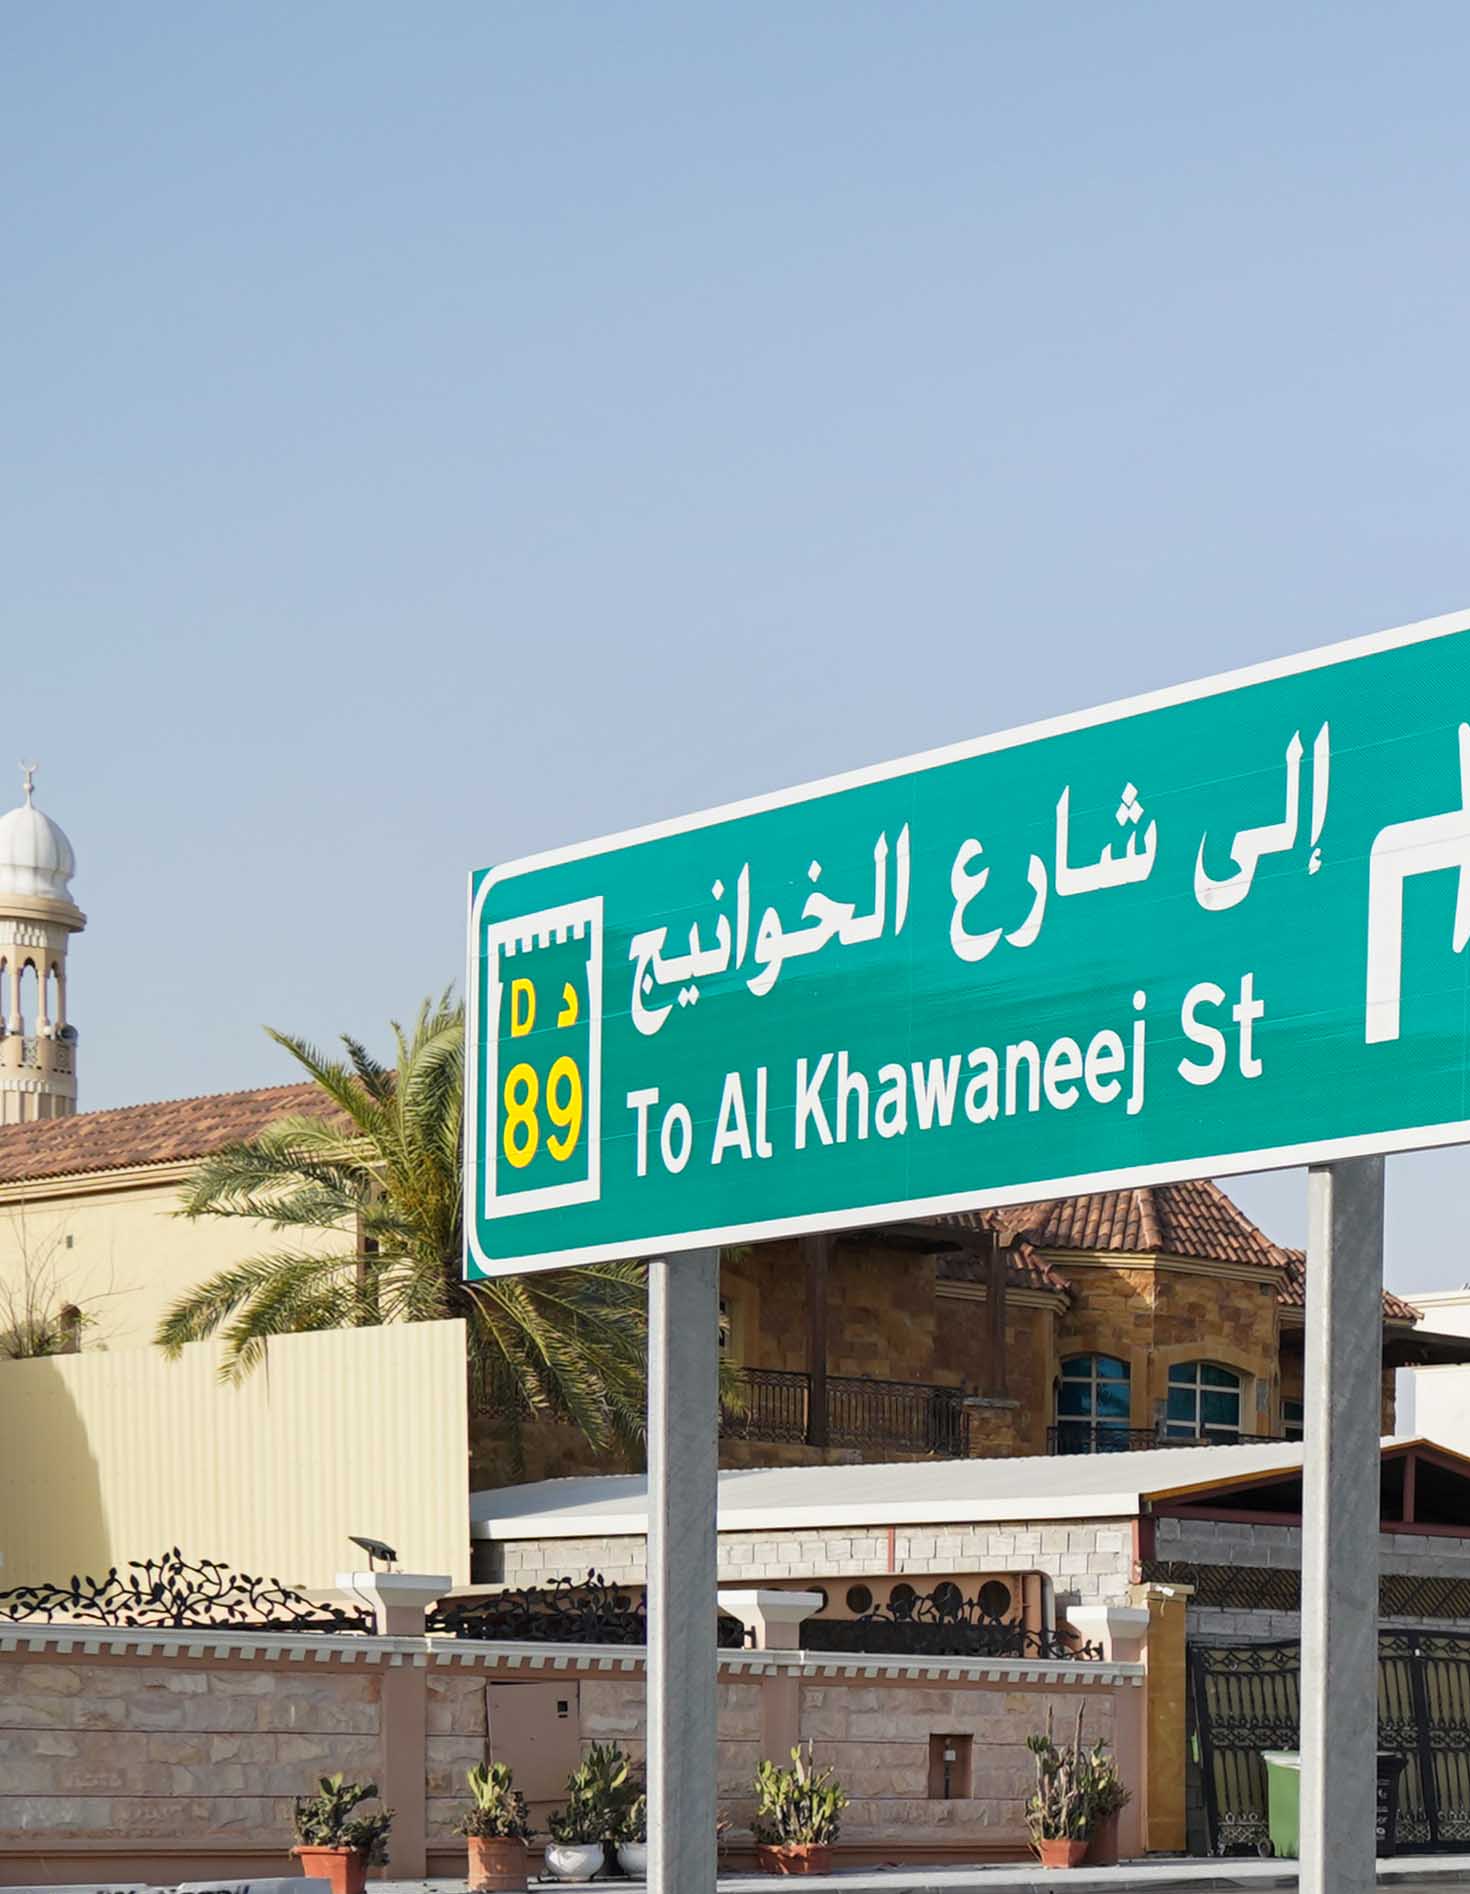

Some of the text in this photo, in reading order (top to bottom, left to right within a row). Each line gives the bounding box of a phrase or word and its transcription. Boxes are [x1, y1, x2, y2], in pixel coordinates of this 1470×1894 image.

[628, 721, 1330, 1036] إلى شارع الخوانيج
[511, 978, 536, 1038] D
[557, 982, 579, 1028] د
[503, 1055, 583, 1169] 89
[626, 972, 1265, 1177] To Al Khawaneej St
